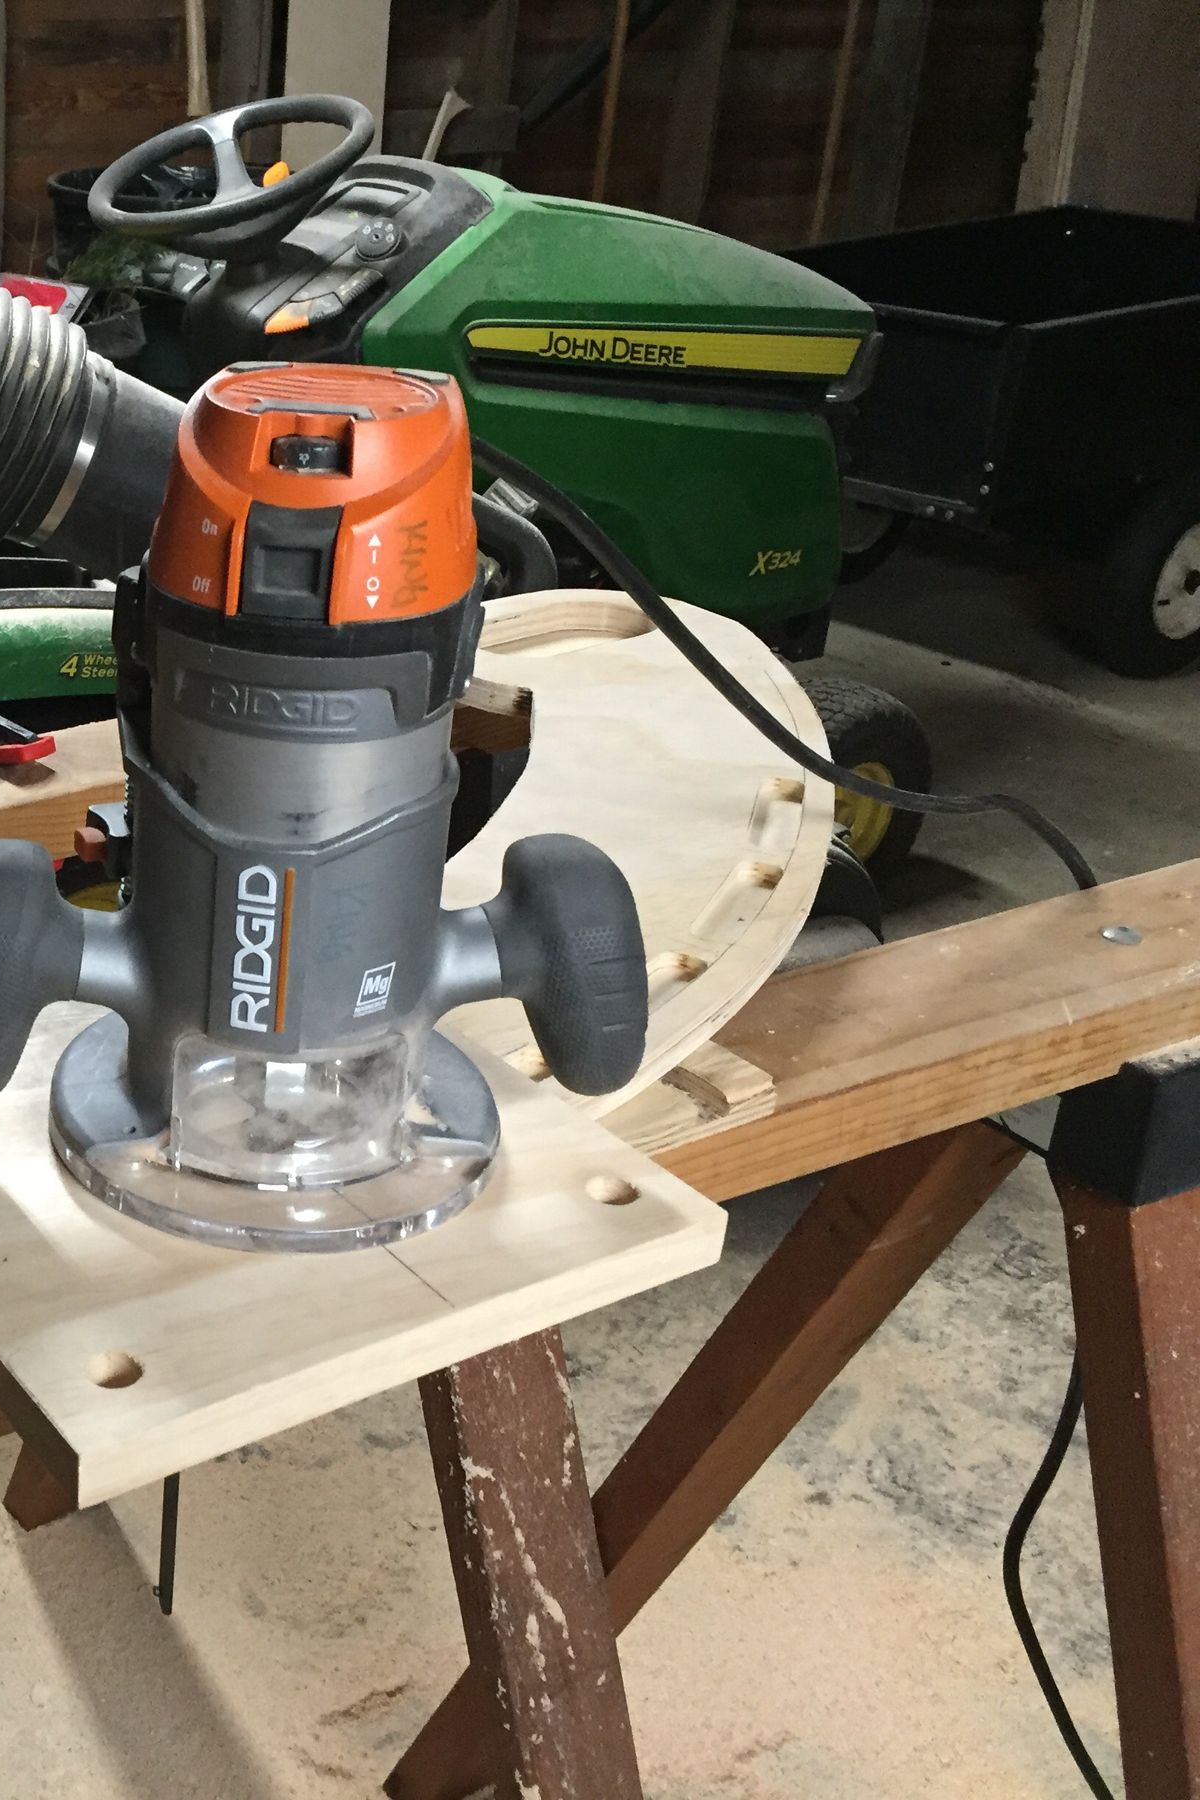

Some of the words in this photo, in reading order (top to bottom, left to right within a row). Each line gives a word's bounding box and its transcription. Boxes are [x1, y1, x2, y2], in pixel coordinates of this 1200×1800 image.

[538, 331, 607, 359] JOHN
[611, 336, 687, 365] DEERE
[201, 518, 218, 536] On
[749, 549, 803, 576] X324
[192, 575, 211, 594] Off
[60, 655, 79, 677] 4
[83, 654, 118, 665] Whee
[81, 666, 118, 678] Stee
[211, 684, 361, 726] RIDGID
[230, 865, 277, 1033] RIDGID
[363, 974, 389, 995] Mg
